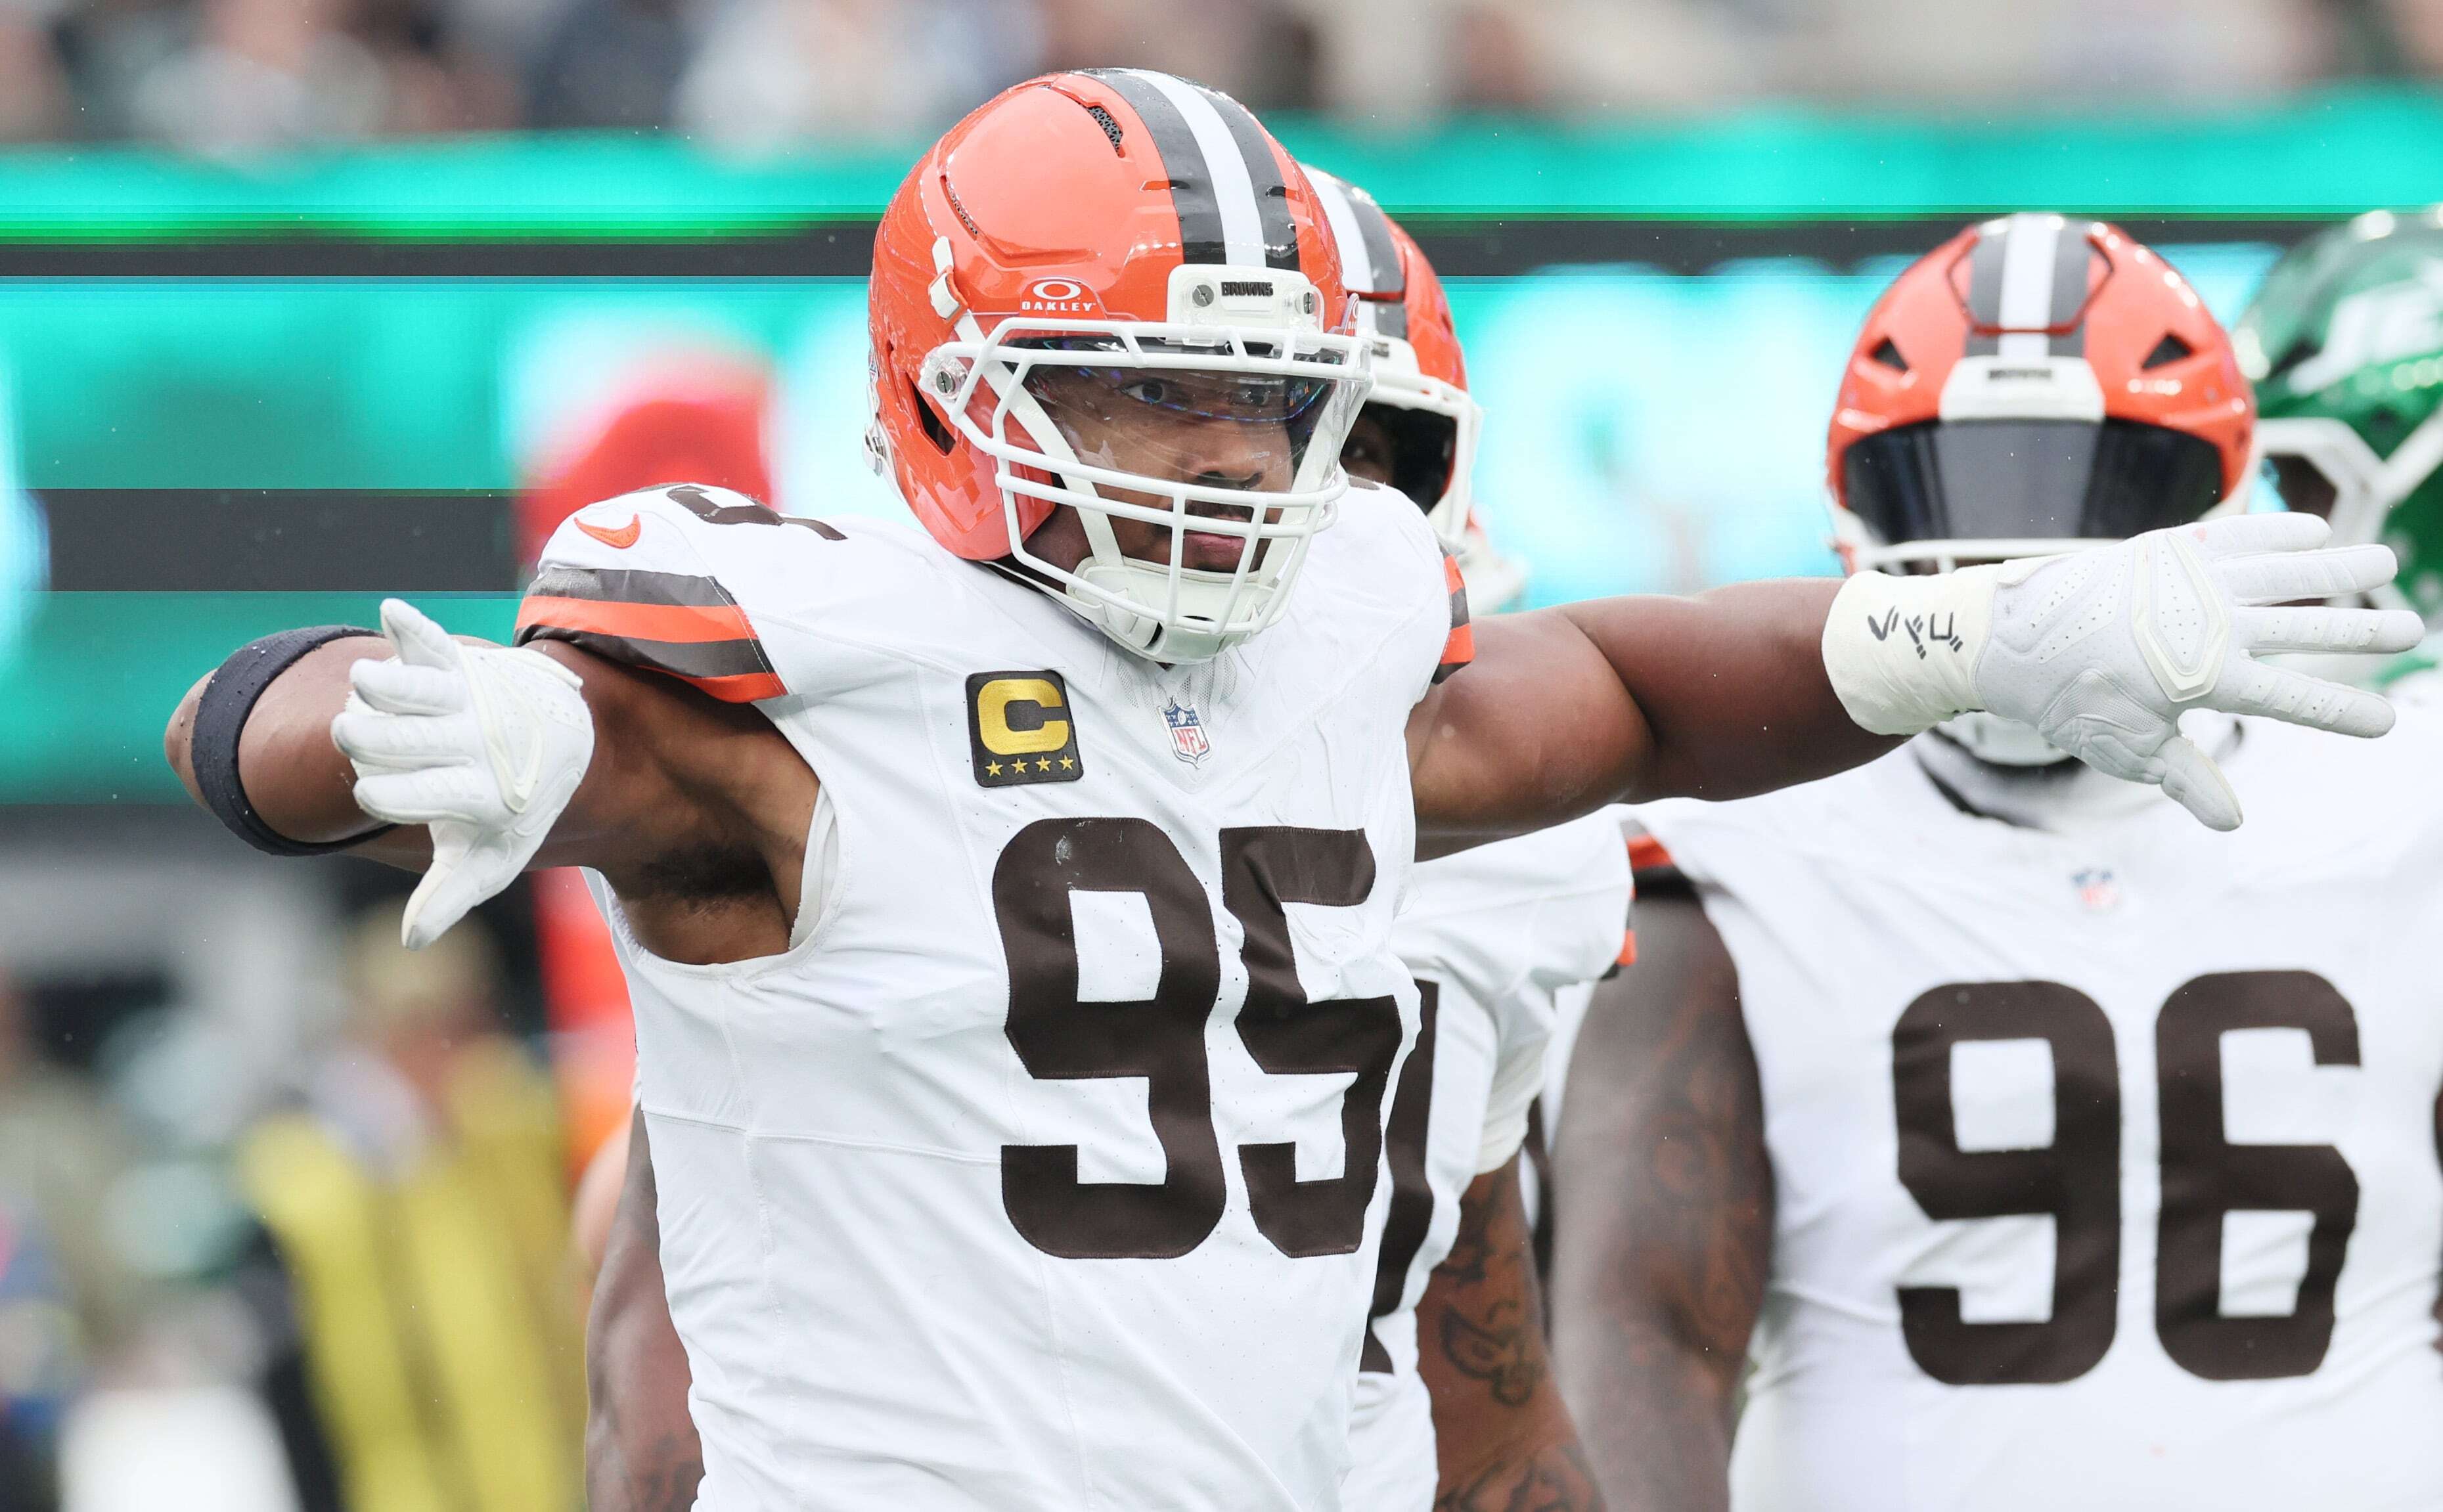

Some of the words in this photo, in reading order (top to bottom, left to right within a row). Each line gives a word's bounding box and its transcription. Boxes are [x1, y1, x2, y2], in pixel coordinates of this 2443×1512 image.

[1021, 301, 1092, 312] OAKLEY
[1221, 281, 1273, 297] BROWNS
[977, 678, 1069, 755] C
[1174, 728, 1207, 755] NFL
[992, 817, 1402, 1258] 95
[1892, 970, 2362, 1385] 96
